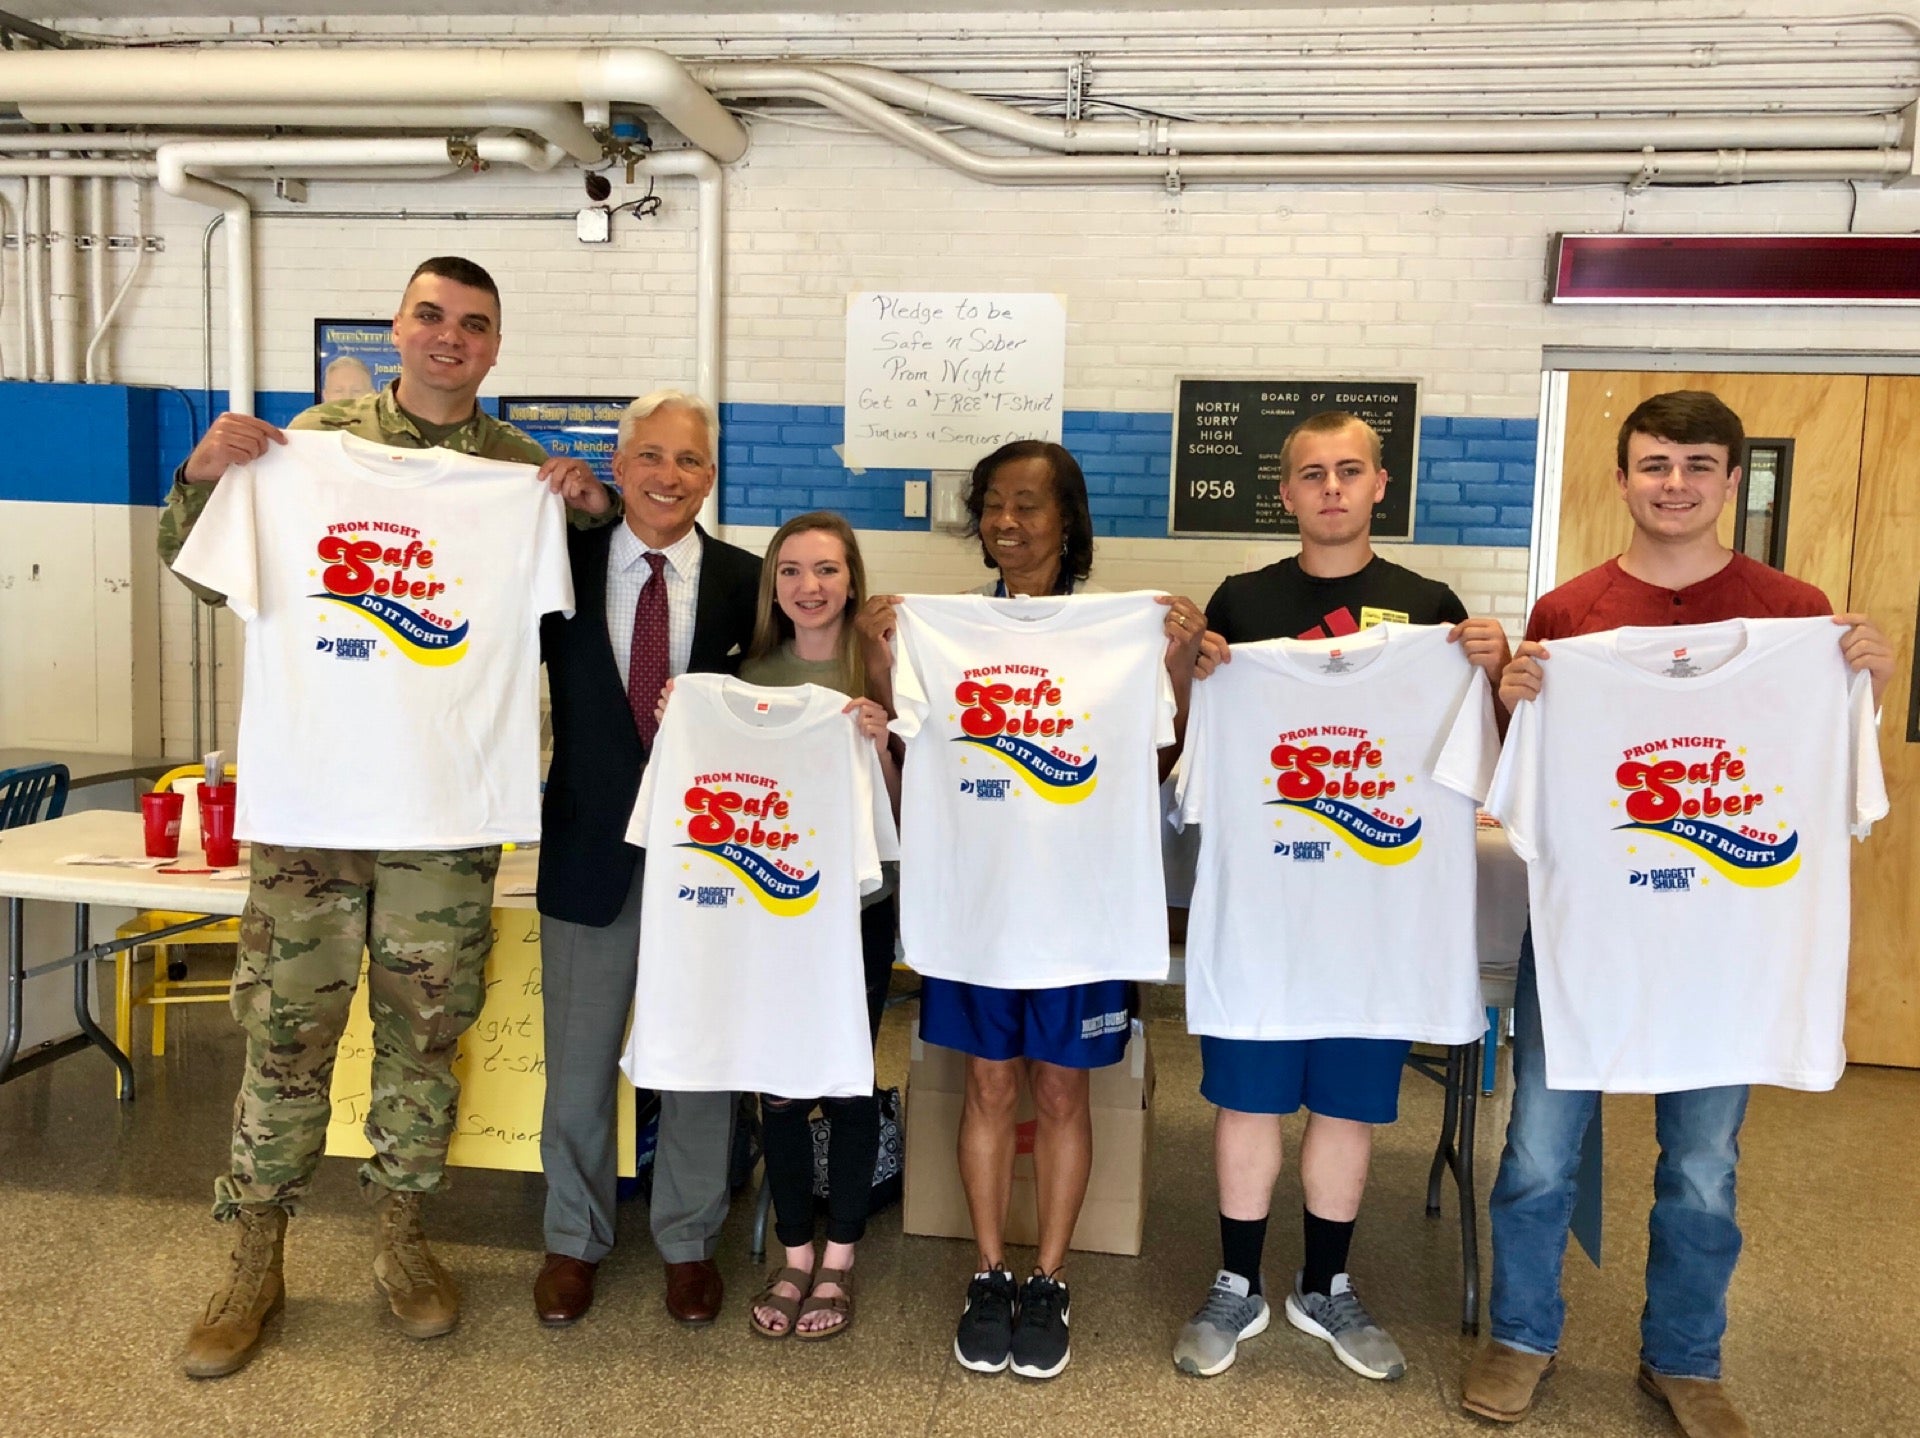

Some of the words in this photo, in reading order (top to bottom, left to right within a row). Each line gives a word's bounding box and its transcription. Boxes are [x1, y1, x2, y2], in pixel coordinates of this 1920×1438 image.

[872, 294, 944, 324] Pledge
[956, 298, 978, 320] to
[987, 302, 1014, 320] be
[872, 331, 932, 351] Safe
[970, 328, 1026, 352] Sober
[882, 356, 928, 382] Prom
[942, 358, 1008, 392] Night
[859, 388, 892, 410] Get
[907, 397, 918, 408] a
[1196, 402, 1240, 412] NORTH
[1261, 392, 1299, 402] BOARD
[1311, 394, 1326, 402] OF
[1336, 394, 1398, 403] EDUCATION
[1197, 416, 1238, 426] SURRY
[854, 424, 918, 439] Juniors
[938, 426, 1000, 445] Seniors
[1200, 430, 1232, 441] HIGH
[552, 440, 570, 454] Ray
[574, 440, 614, 452] Mendez
[1189, 444, 1242, 456] SCHOOL
[1190, 480, 1236, 500] 1958
[328, 522, 368, 534] PROM
[373, 522, 420, 538] NIGHT
[318, 536, 433, 584] Safe
[323, 562, 445, 600] Sober
[361, 597, 382, 612] DO
[384, 606, 402, 620] IT
[399, 620, 449, 644] RIGHT!
[420, 608, 452, 629] 2019
[964, 665, 1001, 679] PROM
[1005, 664, 1048, 678] NIGHT
[955, 679, 1062, 725] Safe
[960, 704, 1074, 738] Sober
[1278, 726, 1318, 742] PROM
[1322, 726, 1368, 738] NIGHT
[996, 737, 1016, 752] DO
[1017, 748, 1032, 762] IT
[1032, 758, 1079, 781] RIGHT!
[1050, 746, 1082, 766] 2019
[1623, 739, 1668, 760] PROM
[1672, 736, 1726, 750] NIGHT
[1271, 741, 1382, 787] Safe
[694, 773, 732, 786] PROM
[735, 773, 778, 790] NIGHT
[1277, 767, 1396, 800] Sober
[1616, 751, 1746, 803] Safe
[684, 787, 789, 833] Safe
[1626, 782, 1764, 823] Sober
[1315, 800, 1336, 814] DO
[1336, 810, 1353, 823] IT
[1352, 818, 1401, 842] RIGHT!
[1372, 808, 1404, 827] 2019
[688, 814, 799, 850] Sober
[1672, 821, 1696, 836] DO
[1700, 830, 1718, 844] IT
[1717, 838, 1776, 862] RIGHT!
[1738, 825, 1778, 844] 2019
[722, 846, 742, 860] DO
[741, 856, 758, 870] IT
[756, 866, 800, 894] RIGHT!
[774, 859, 804, 879] 2019
[1650, 867, 1696, 880] DAGGETT
[1652, 878, 1690, 889] SHULER
